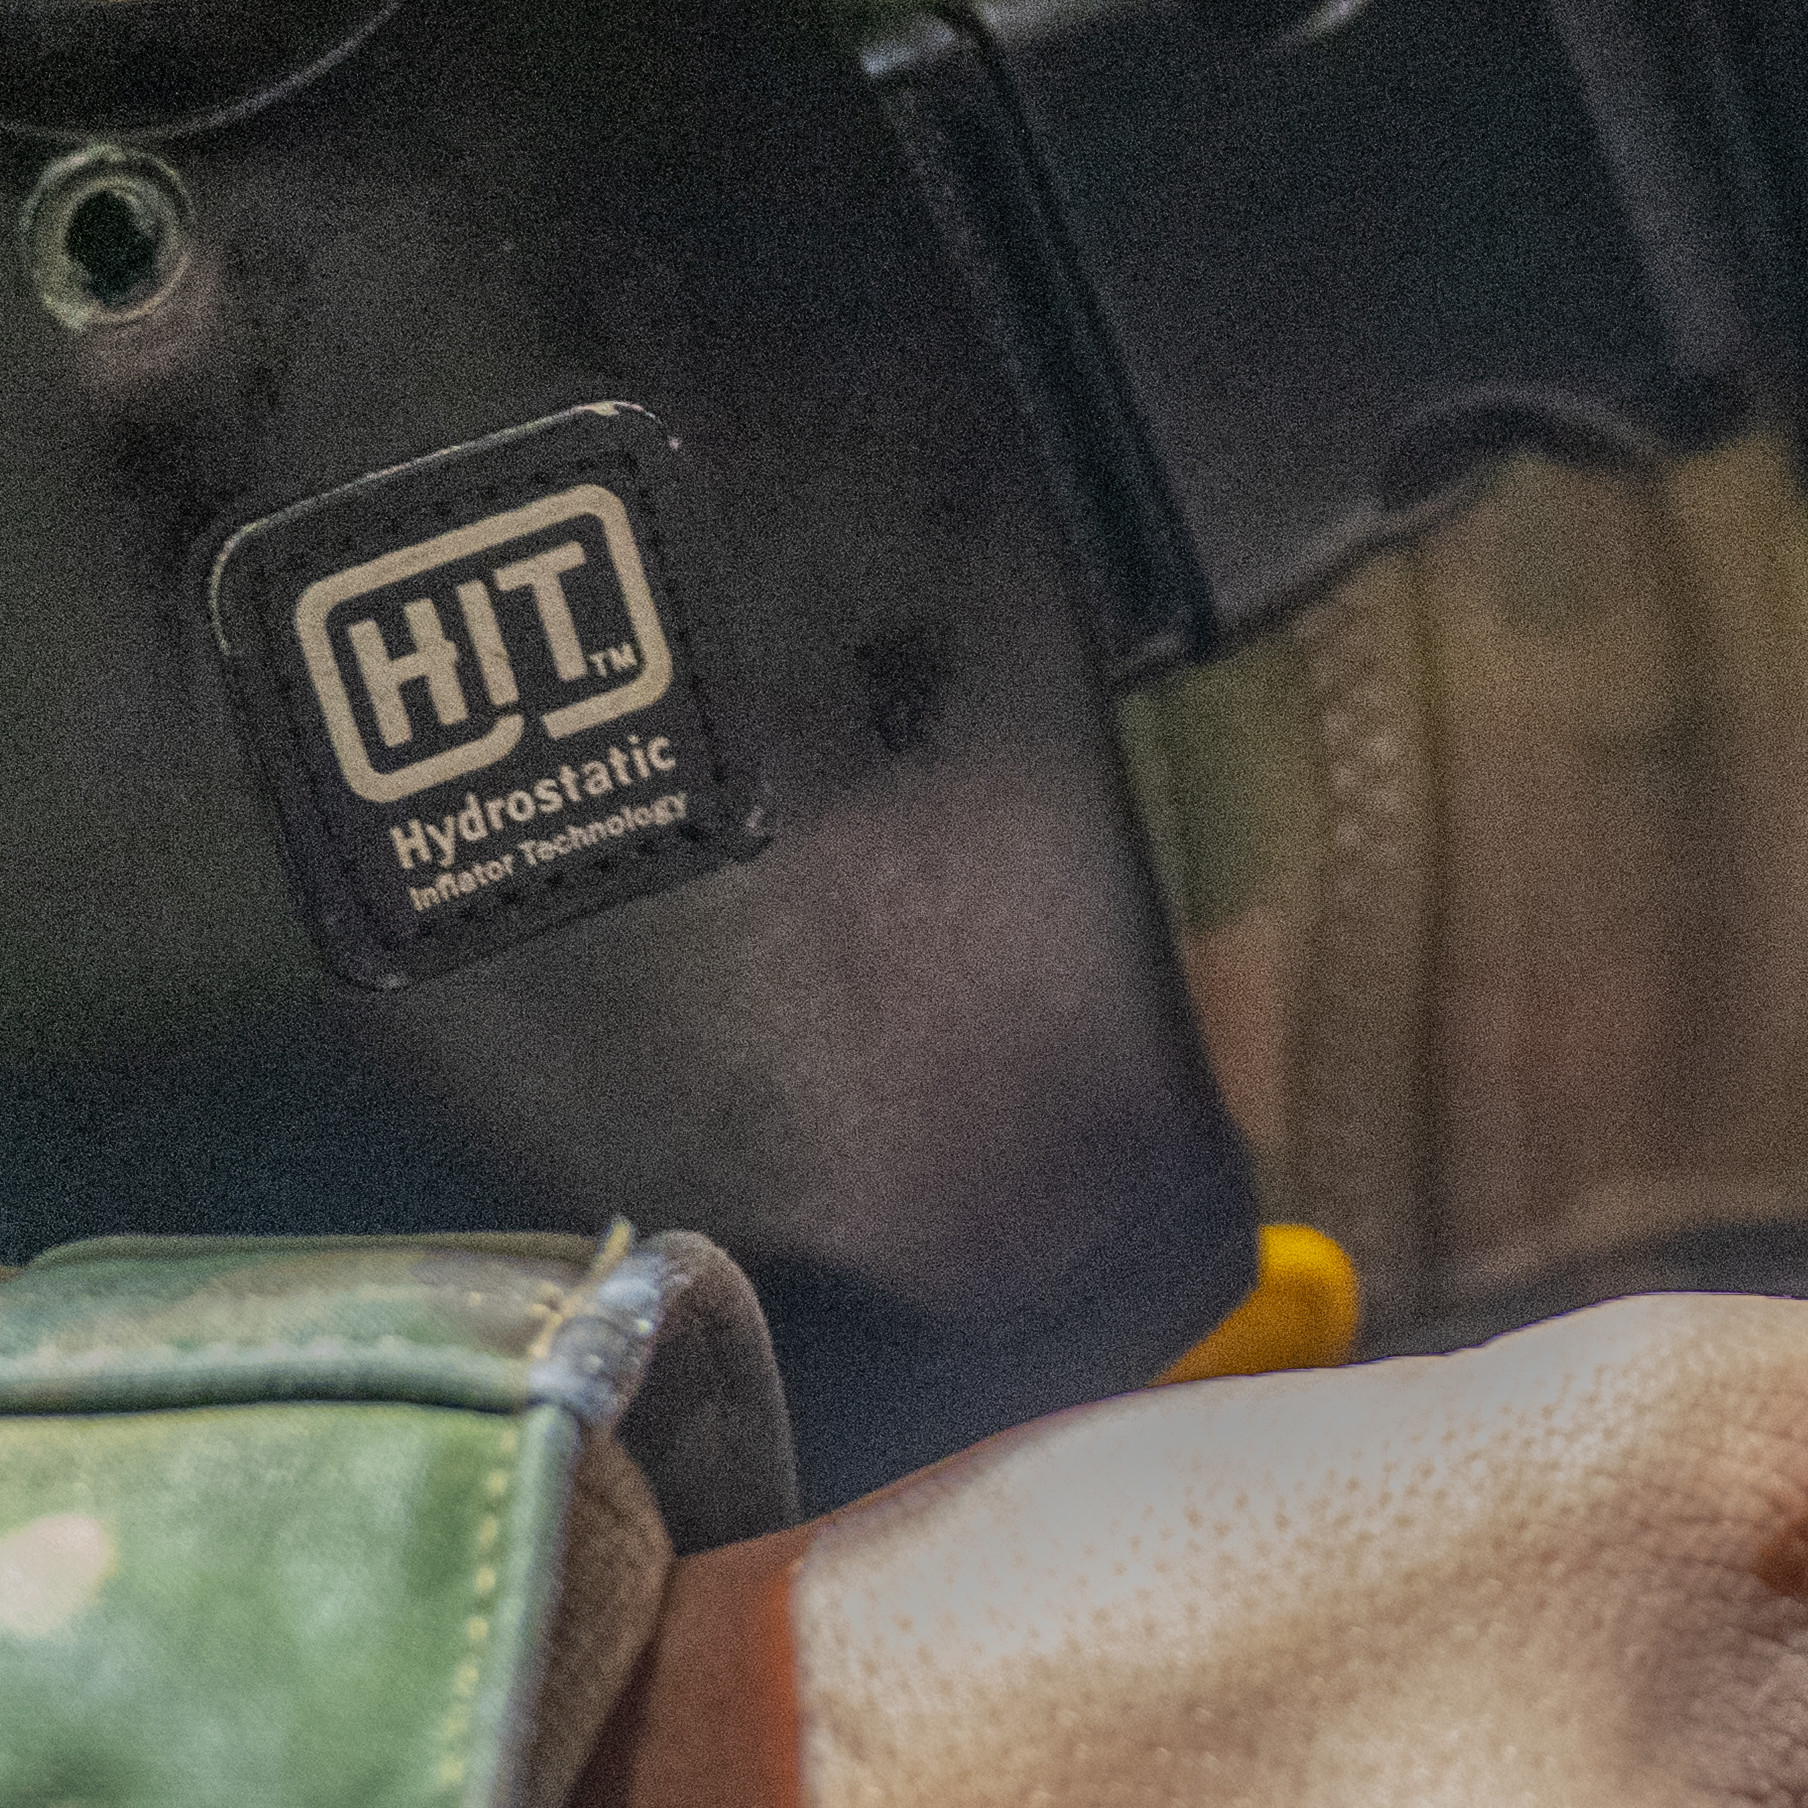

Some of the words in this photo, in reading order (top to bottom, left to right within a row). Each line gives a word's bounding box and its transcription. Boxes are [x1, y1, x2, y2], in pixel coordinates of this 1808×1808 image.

[350, 541, 585, 747] HIT
[589, 644, 637, 677] TM
[390, 736, 676, 869] Hydrostatic
[409, 854, 513, 911] Inflator
[518, 792, 686, 866] Technology
